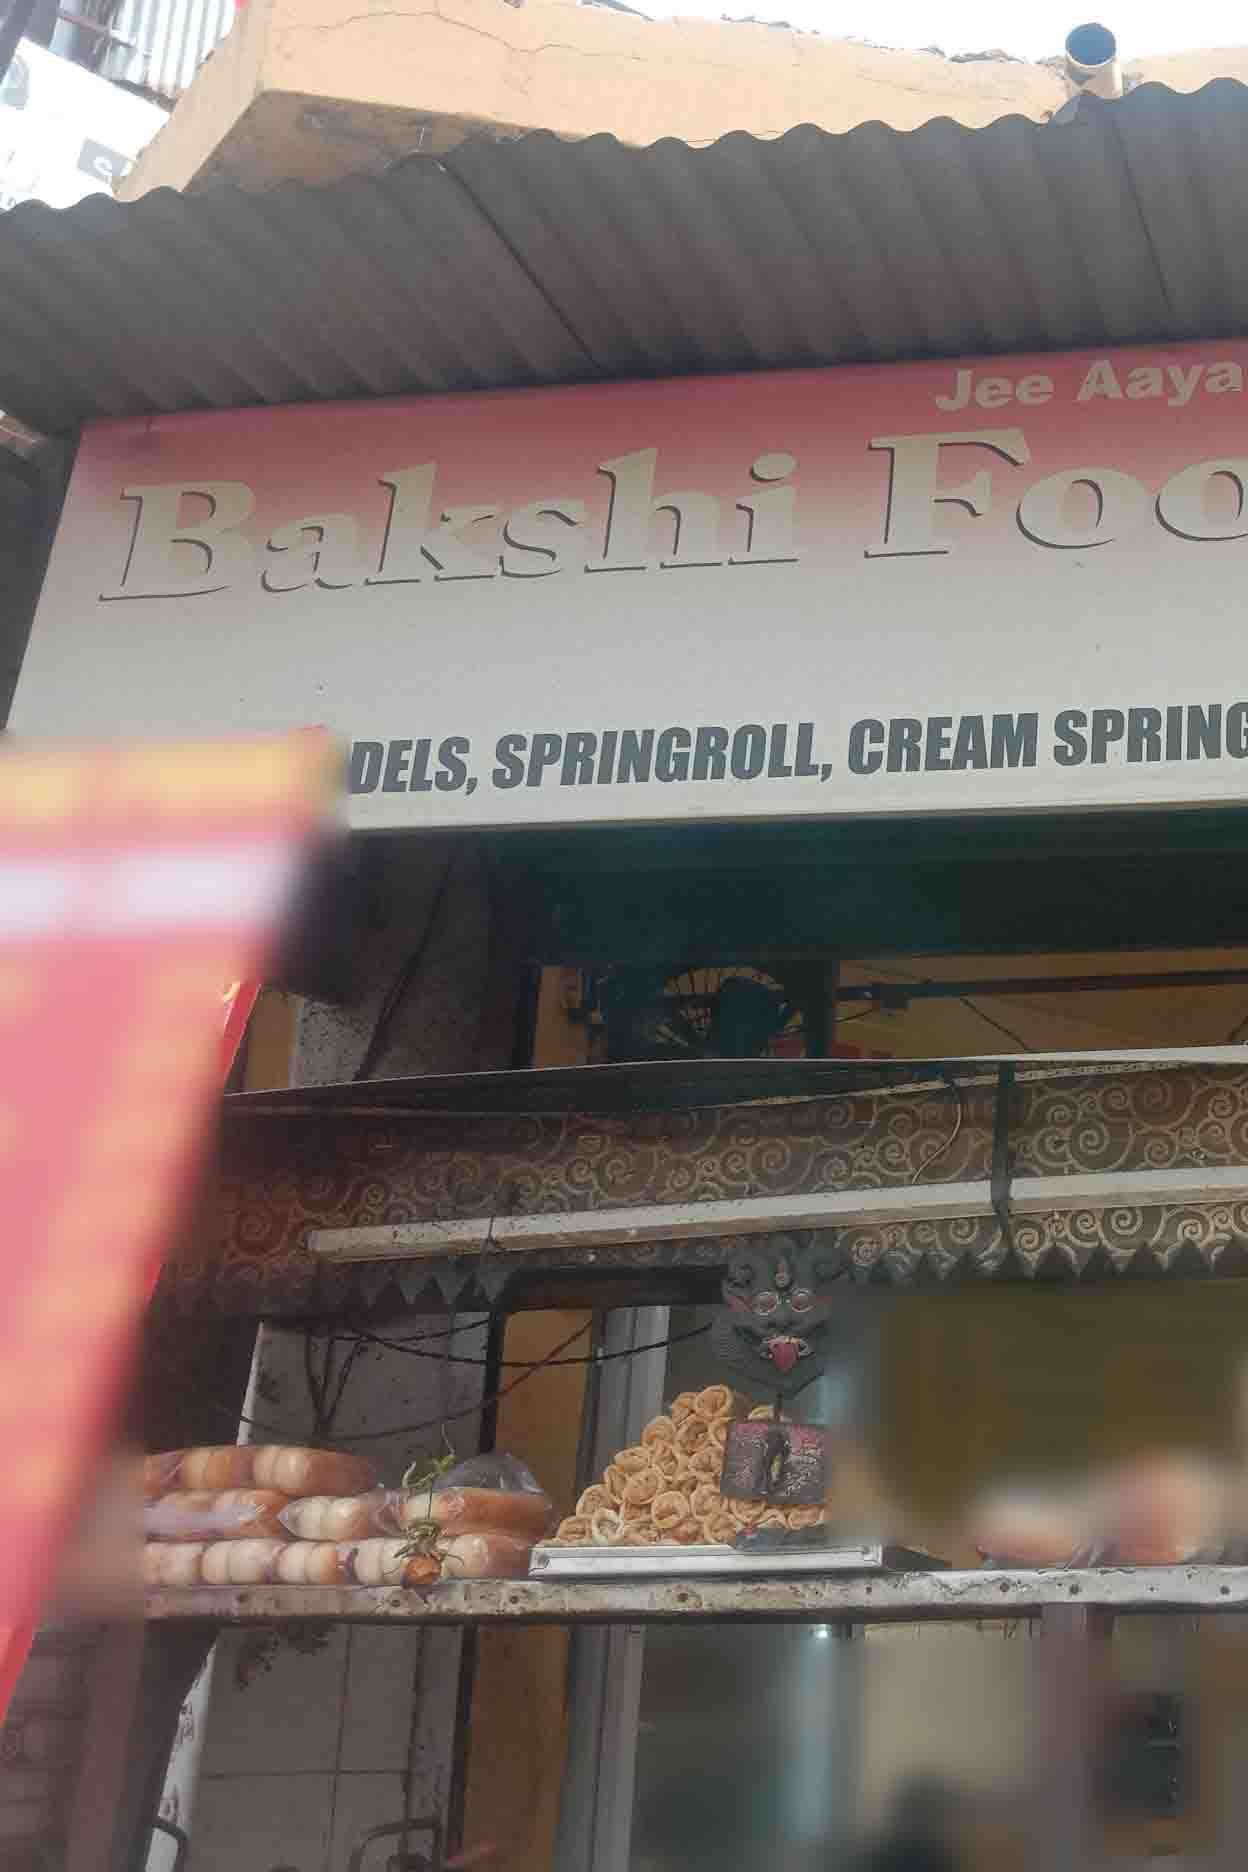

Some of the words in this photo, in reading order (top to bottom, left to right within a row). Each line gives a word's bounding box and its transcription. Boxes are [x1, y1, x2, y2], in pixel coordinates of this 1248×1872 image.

[935, 369, 1055, 412] Jee
[98, 448, 798, 602] Bakshi
[491, 722, 833, 785] SPRINGROLL,
[848, 713, 1039, 775] CREAM
